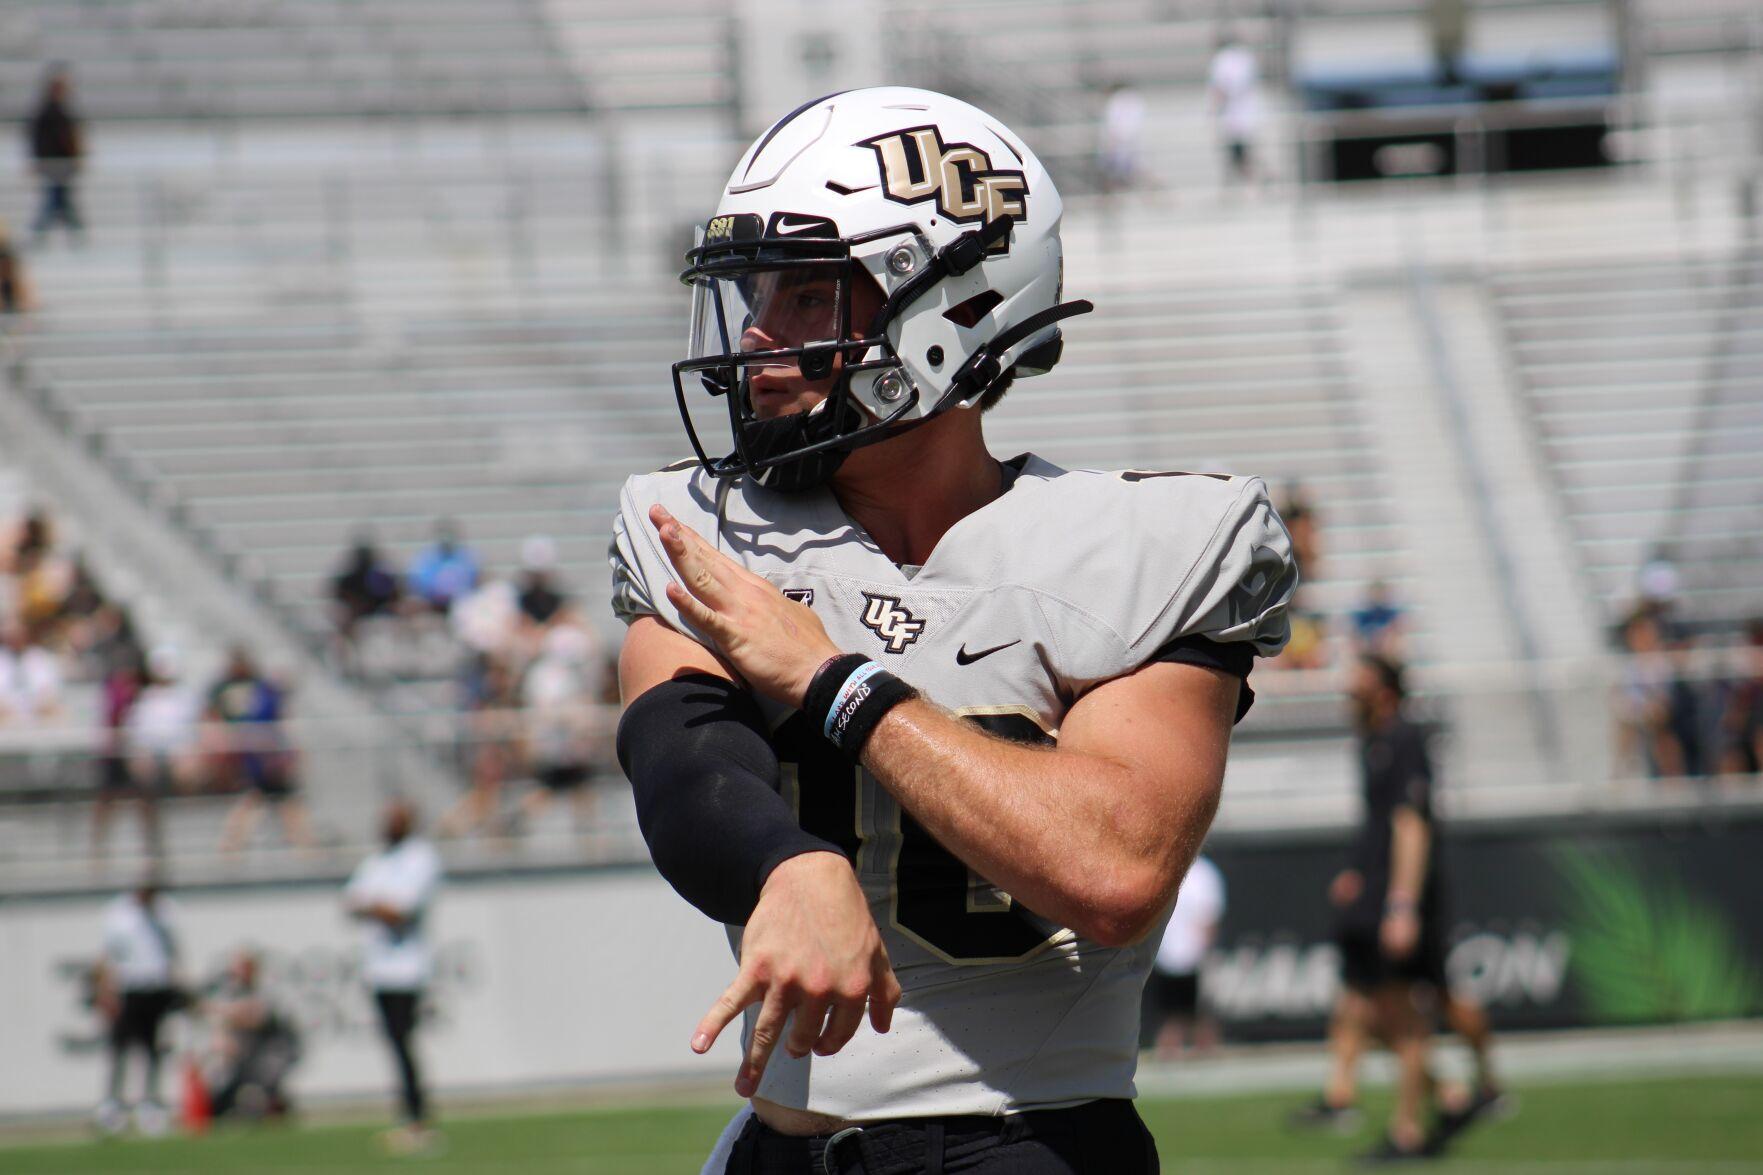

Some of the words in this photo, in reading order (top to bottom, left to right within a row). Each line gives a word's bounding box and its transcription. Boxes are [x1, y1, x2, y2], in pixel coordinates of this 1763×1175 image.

[853, 124, 1029, 255] UCF
[861, 591, 926, 654] UCF
[838, 684, 871, 731] SECOND
